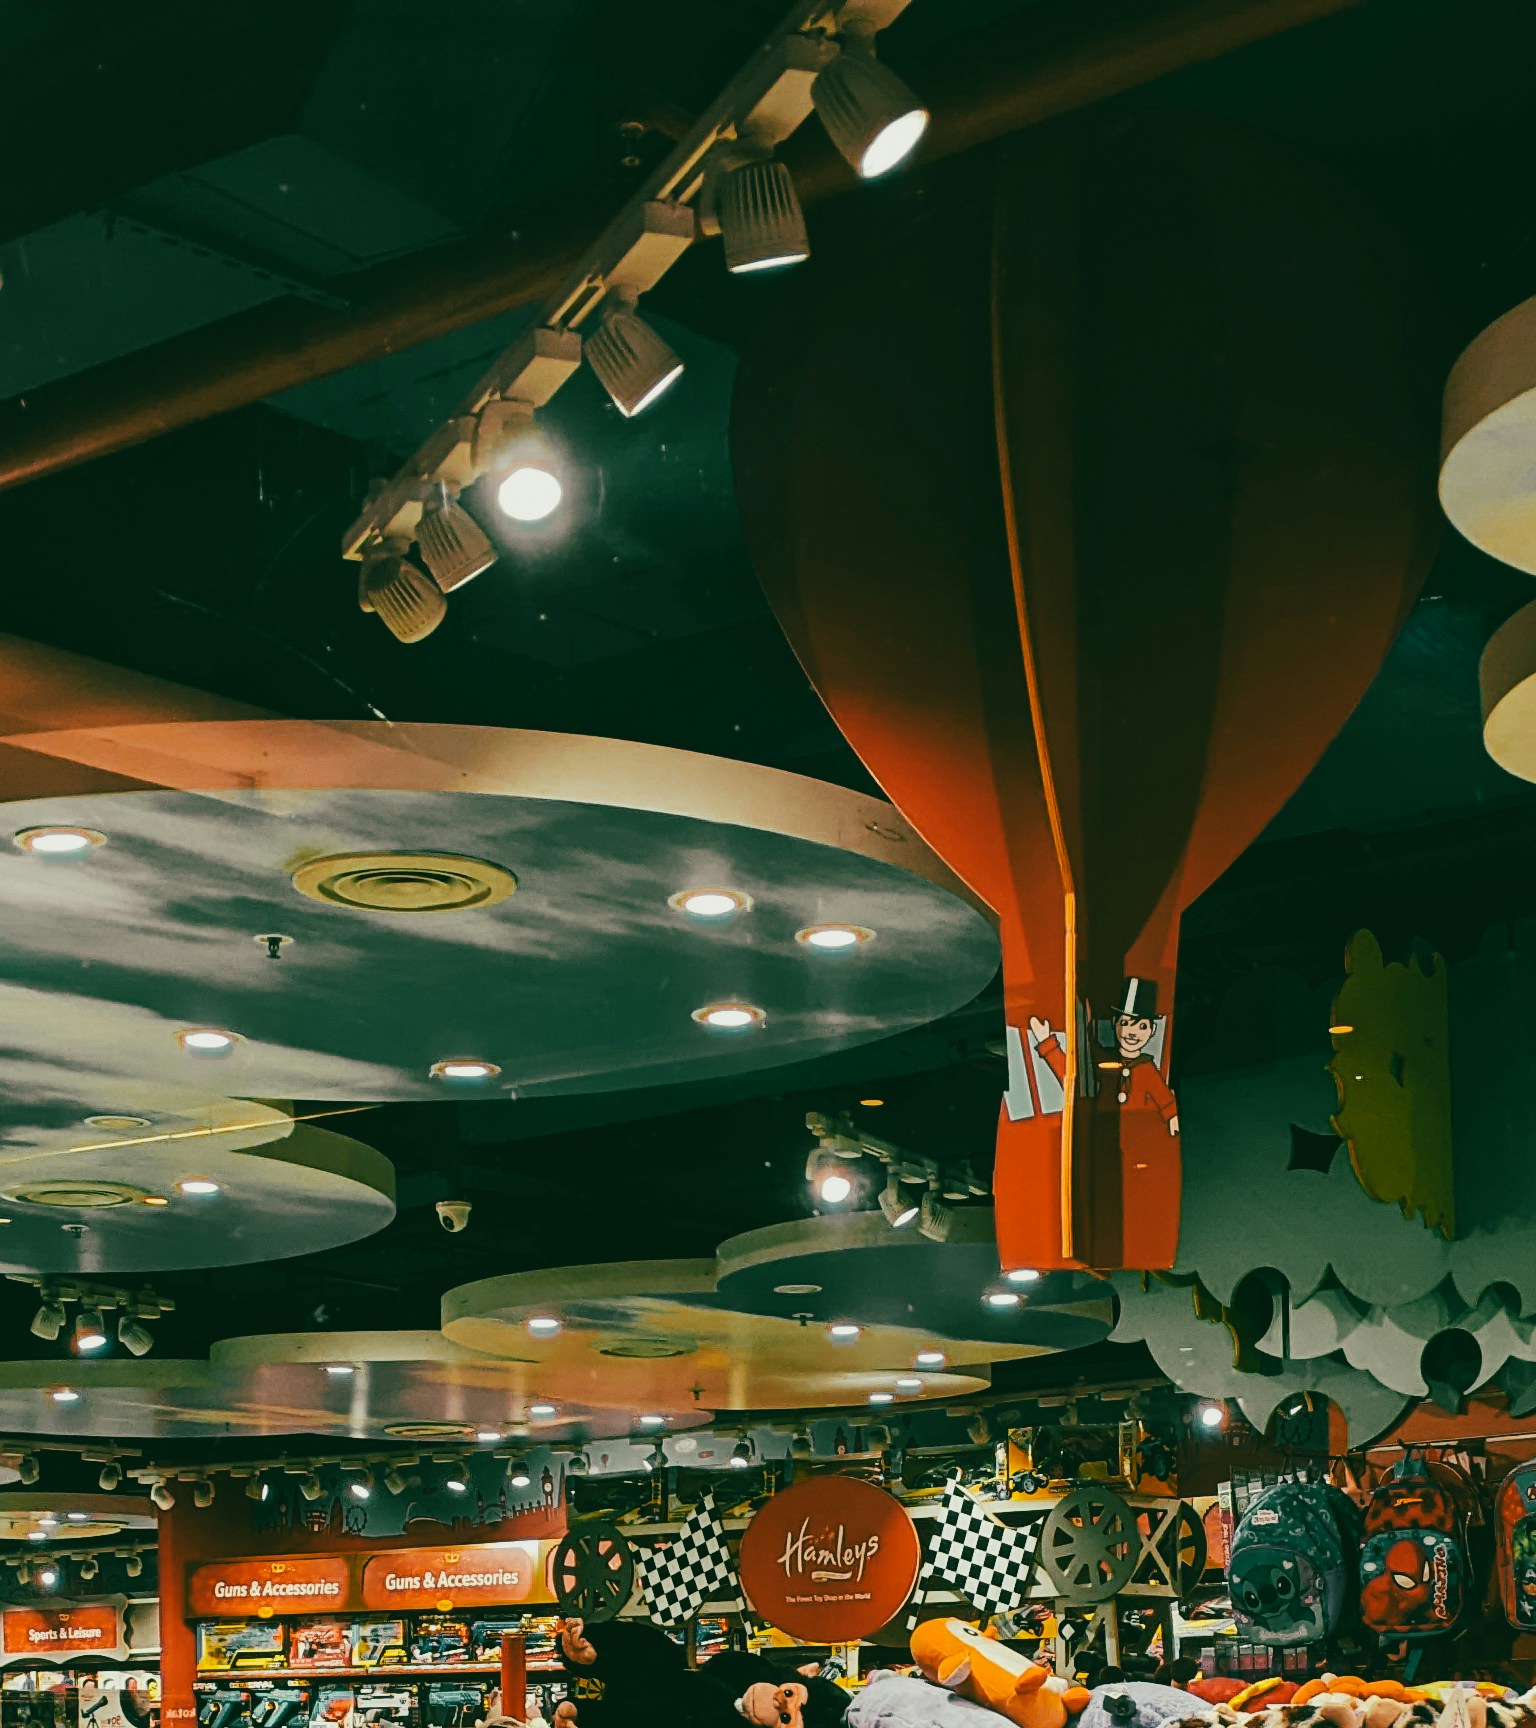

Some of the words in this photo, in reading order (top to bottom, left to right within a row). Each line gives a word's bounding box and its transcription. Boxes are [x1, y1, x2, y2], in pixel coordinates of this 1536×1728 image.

[777, 1516, 880, 1583] Hamleys
[214, 1580, 248, 1599] Guns
[249, 1580, 261, 1598] &
[262, 1579, 340, 1598] Accessories
[385, 1573, 421, 1591] Guns
[423, 1571, 436, 1589] &
[437, 1568, 519, 1589] Accessories
[28, 1628, 58, 1643] Sports
[59, 1628, 67, 1640] &
[68, 1627, 102, 1640] Leisure
